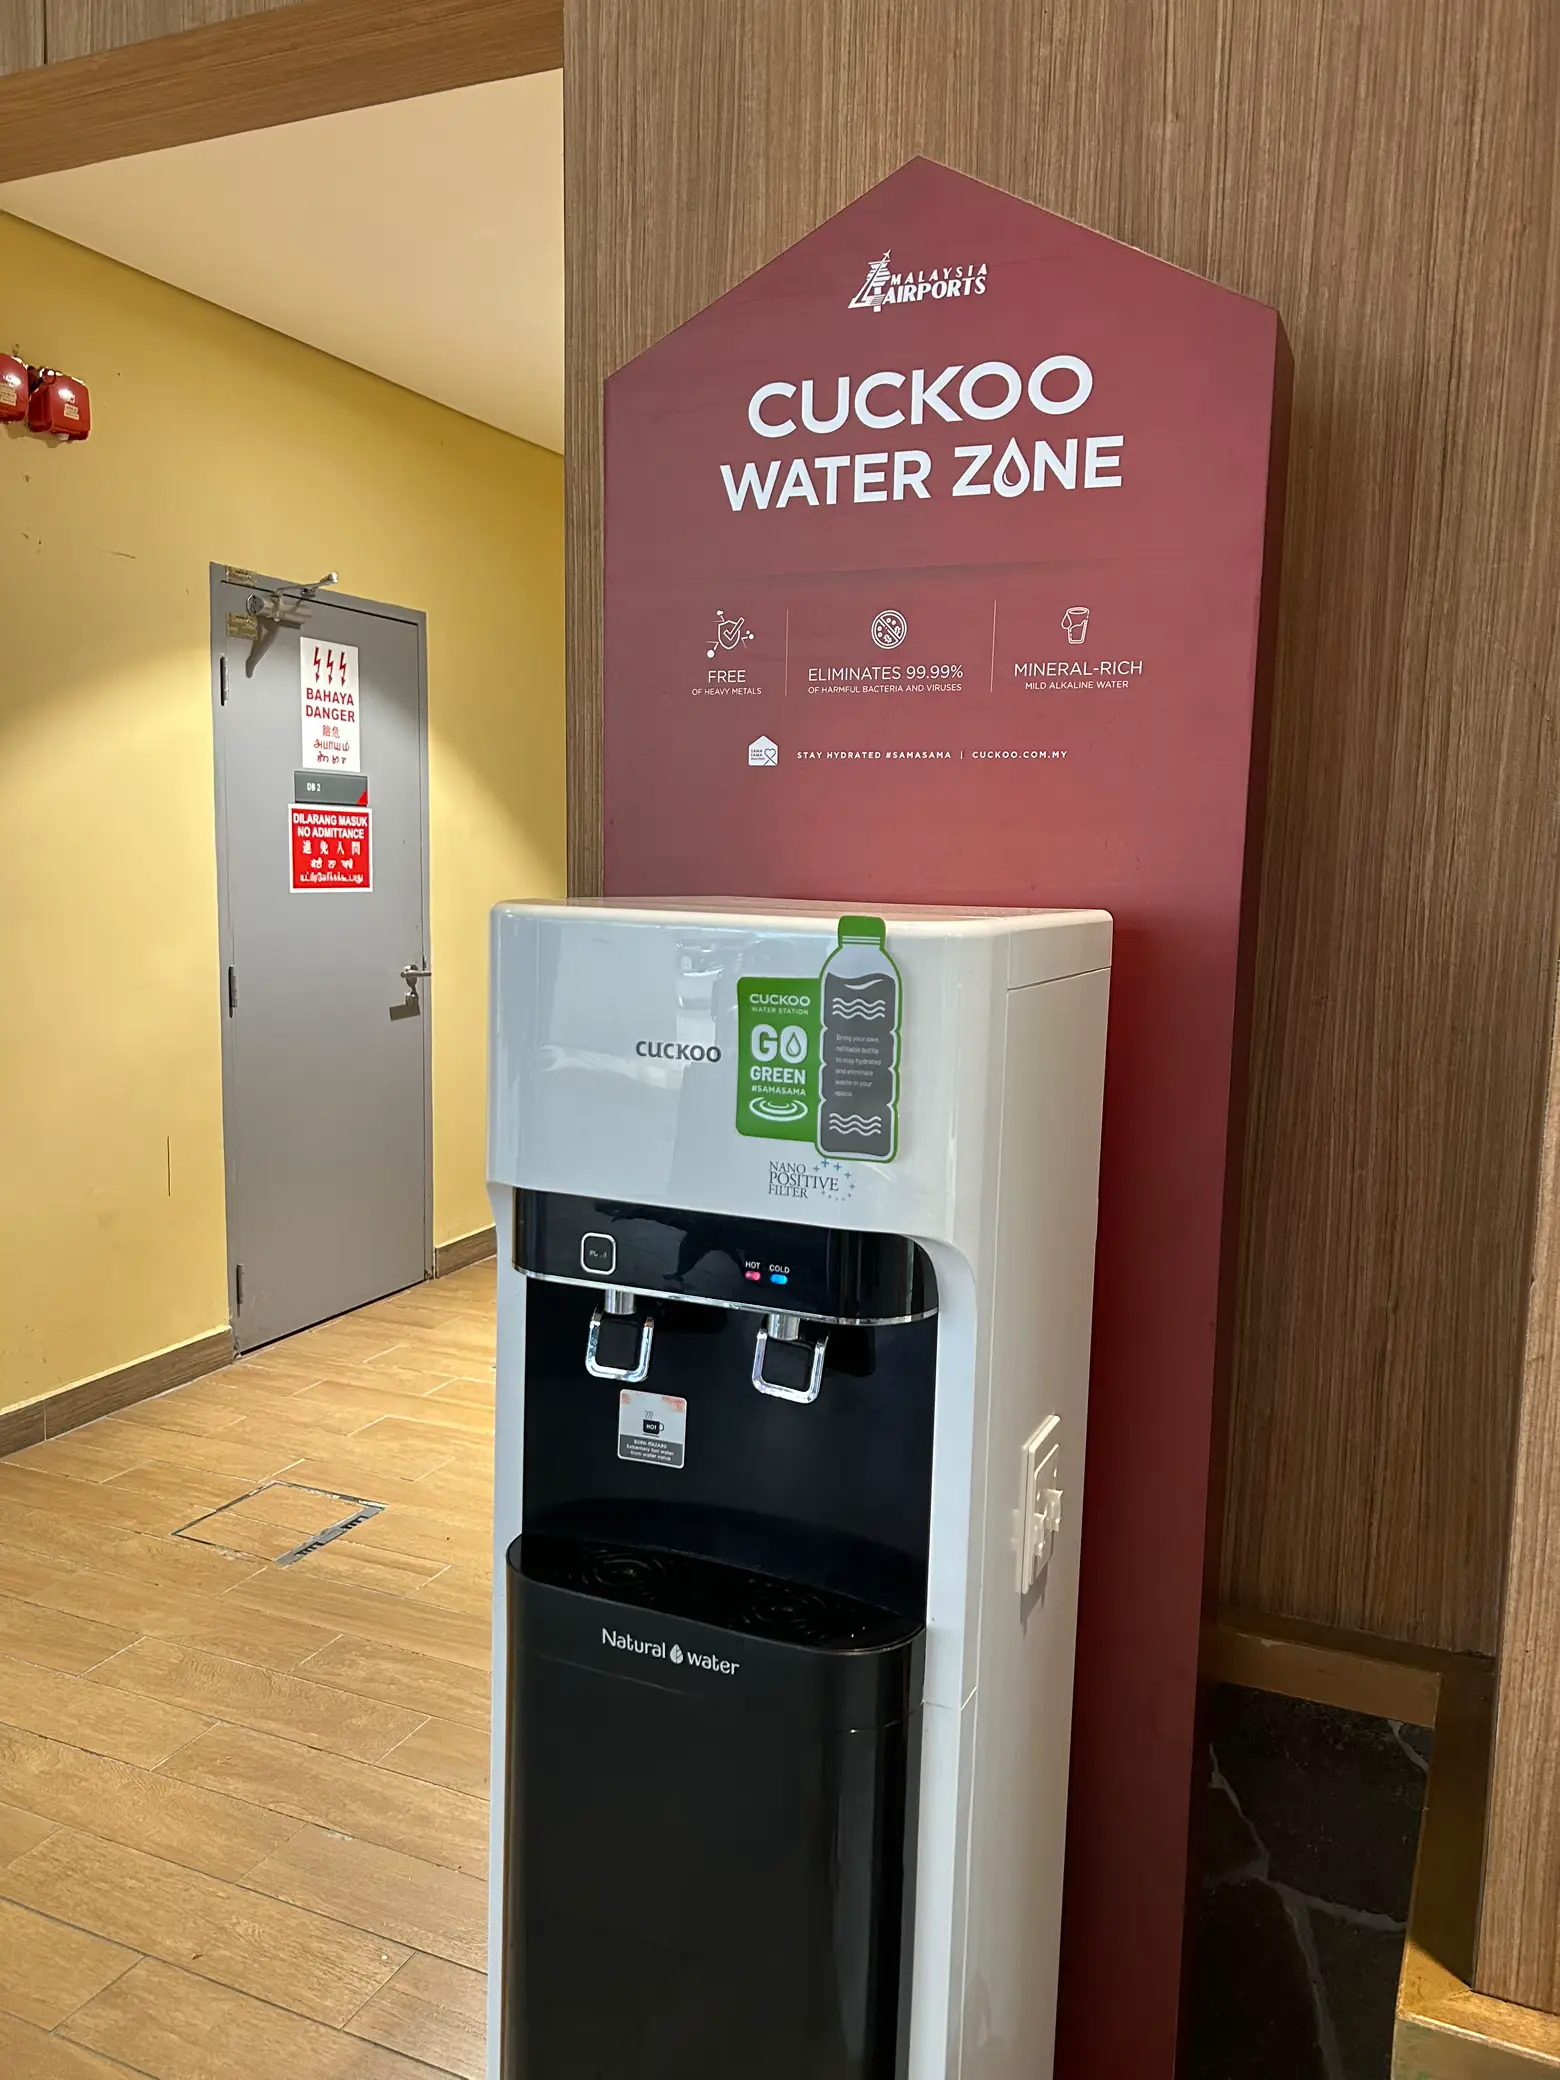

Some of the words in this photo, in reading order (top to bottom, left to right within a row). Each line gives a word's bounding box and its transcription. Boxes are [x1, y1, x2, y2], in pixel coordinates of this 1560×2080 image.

[890, 263, 988, 286] MALAYSIA
[882, 276, 986, 305] AIRPORTS
[748, 354, 1093, 438] CUCKOO
[720, 449, 932, 512] WATER
[952, 434, 1124, 498] ZONE
[708, 669, 746, 683] FREE
[808, 666, 902, 682] ELIMINATES
[906, 664, 964, 680] 99.99%
[1014, 660, 1143, 677] MINERAL-RICH
[691, 688, 703, 696] OF
[704, 687, 730, 695] HEAVY
[731, 687, 762, 695] METALS
[808, 686, 819, 694] OF
[821, 685, 861, 694] HARMFUL
[862, 684, 903, 693] BACTERIA
[905, 684, 925, 692] AND
[926, 683, 962, 692] VIRUSES
[1025, 681, 1047, 690] MILD
[1049, 681, 1094, 690] ALKALINE
[1096, 680, 1129, 689] WATER
[306, 687, 354, 706] BAHAYA
[305, 704, 355, 723] DANGER
[797, 751, 822, 759] STAY
[826, 751, 881, 759] HYDRATED
[885, 751, 951, 759] #SAMASAMA
[972, 750, 1067, 759] CUCKOO.COM.MY
[306, 782, 316, 791] DB
[316, 783, 321, 792] 2
[293, 812, 337, 826] DILARANG
[338, 815, 368, 827] MASUK
[297, 826, 311, 837] NO
[312, 827, 364, 839] ADMITTANCE
[750, 993, 811, 1007] CUCKOO
[751, 1006, 777, 1014] WATER
[778, 1007, 809, 1016] STATION
[636, 1040, 722, 1063] CUCKOO
[751, 1024, 808, 1064] GO
[750, 1065, 806, 1085] GREEN
[751, 1085, 807, 1096] #SAMASAMA
[769, 1160, 807, 1174] NANO
[769, 1171, 839, 1191] POSITIVE
[768, 1183, 808, 1199] FILTER
[745, 1260, 761, 1270] HOT
[769, 1263, 790, 1274] COLD
[602, 1627, 666, 1659] Natural
[687, 1651, 740, 1675] water
